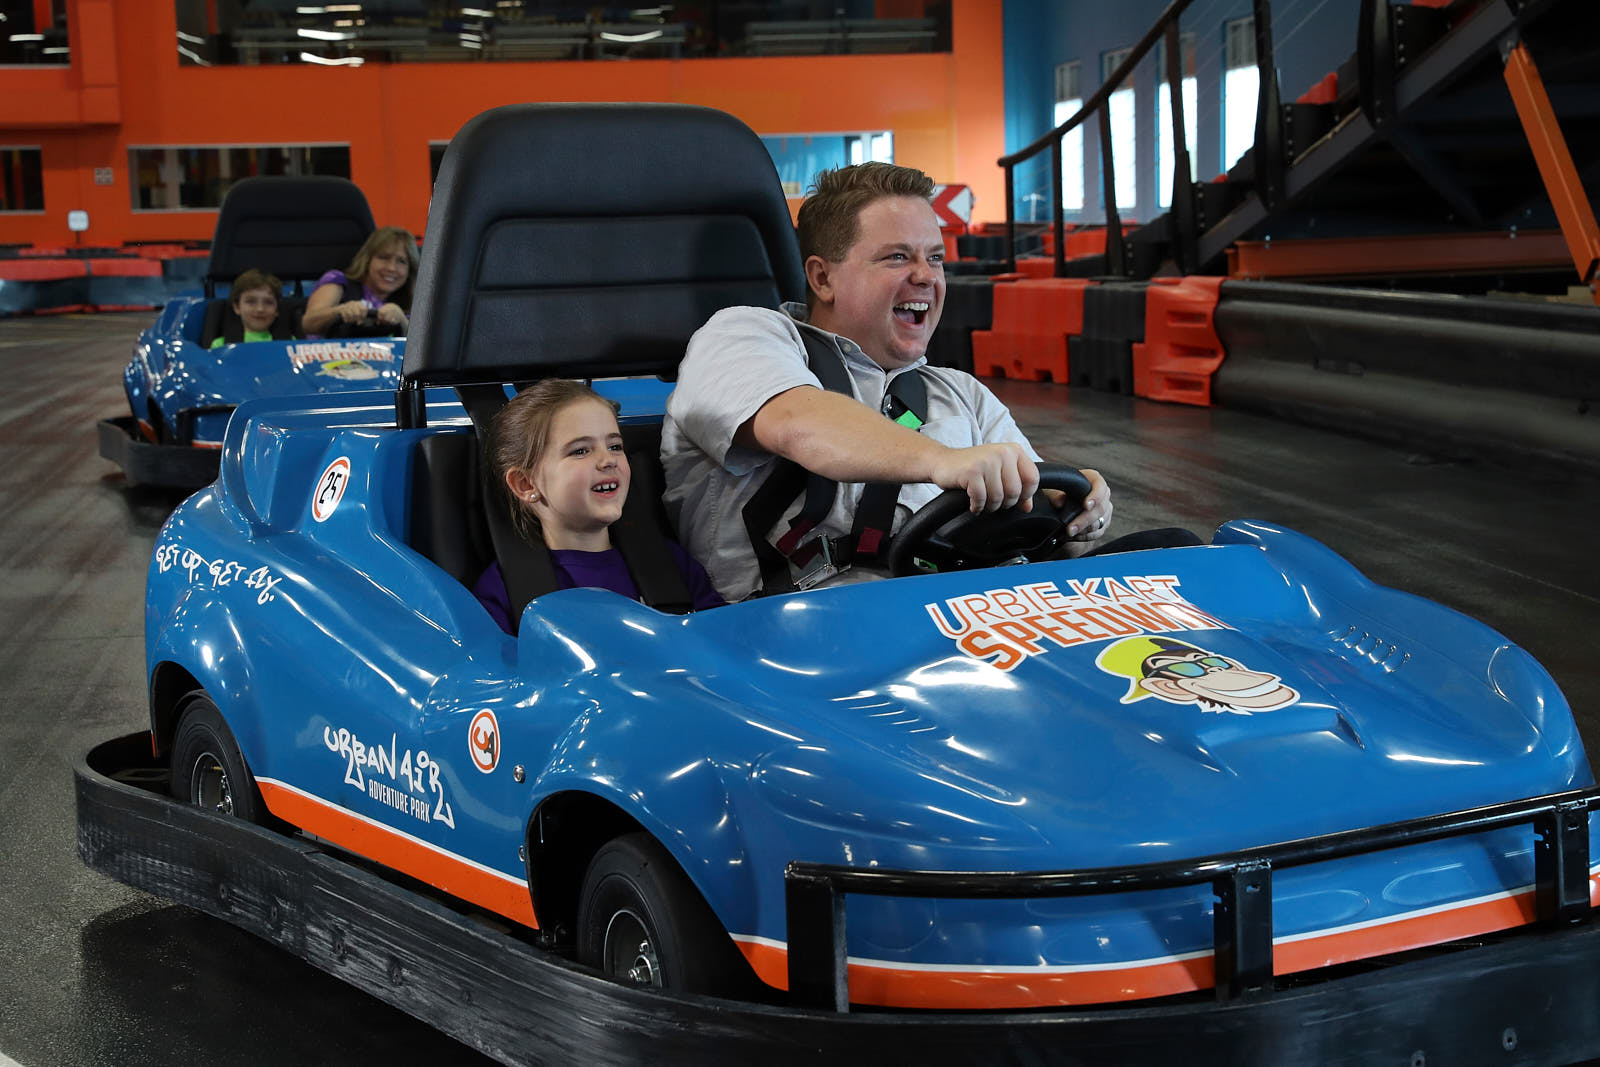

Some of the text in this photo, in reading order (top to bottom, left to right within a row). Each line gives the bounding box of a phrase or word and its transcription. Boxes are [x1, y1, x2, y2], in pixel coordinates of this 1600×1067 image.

[319, 472, 343, 504] 25
[156, 544, 180, 574] GET
[209, 559, 247, 588] GET
[926, 575, 1184, 638] URBIE-KART
[324, 726, 397, 793] URBAN
[368, 779, 431, 824] ADVENTURE PARK
